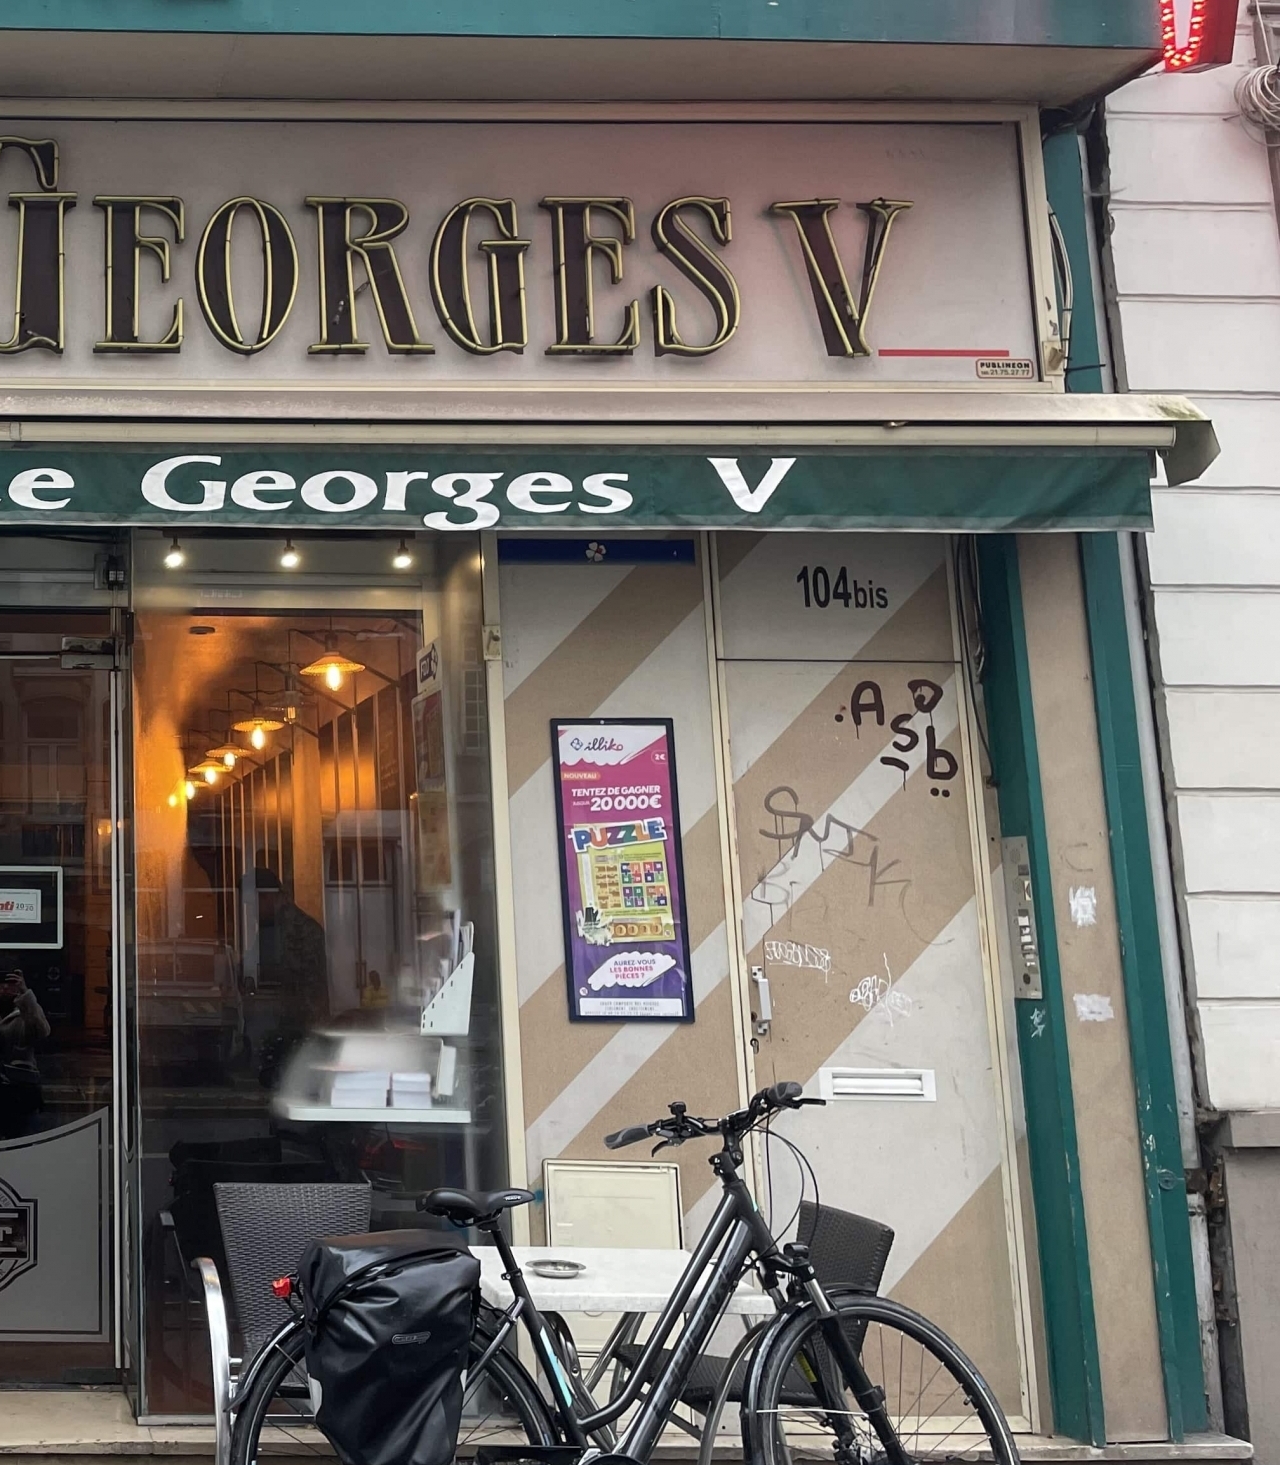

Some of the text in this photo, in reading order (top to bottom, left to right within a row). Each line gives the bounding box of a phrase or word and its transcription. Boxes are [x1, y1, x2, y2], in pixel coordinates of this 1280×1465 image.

[770, 198, 915, 359] V
[140, 455, 634, 532] Georges
[707, 457, 797, 513] V
[584, 737, 624, 751] illiko
[654, 753, 666, 761] 2€
[563, 772, 598, 780] NOUVEAU
[571, 785, 661, 797] TENTEZ DE GAGNER
[573, 820, 666, 851] PUZZLE
[623, 965, 654, 973] BONNES
[615, 972, 640, 980] PIÈCES
